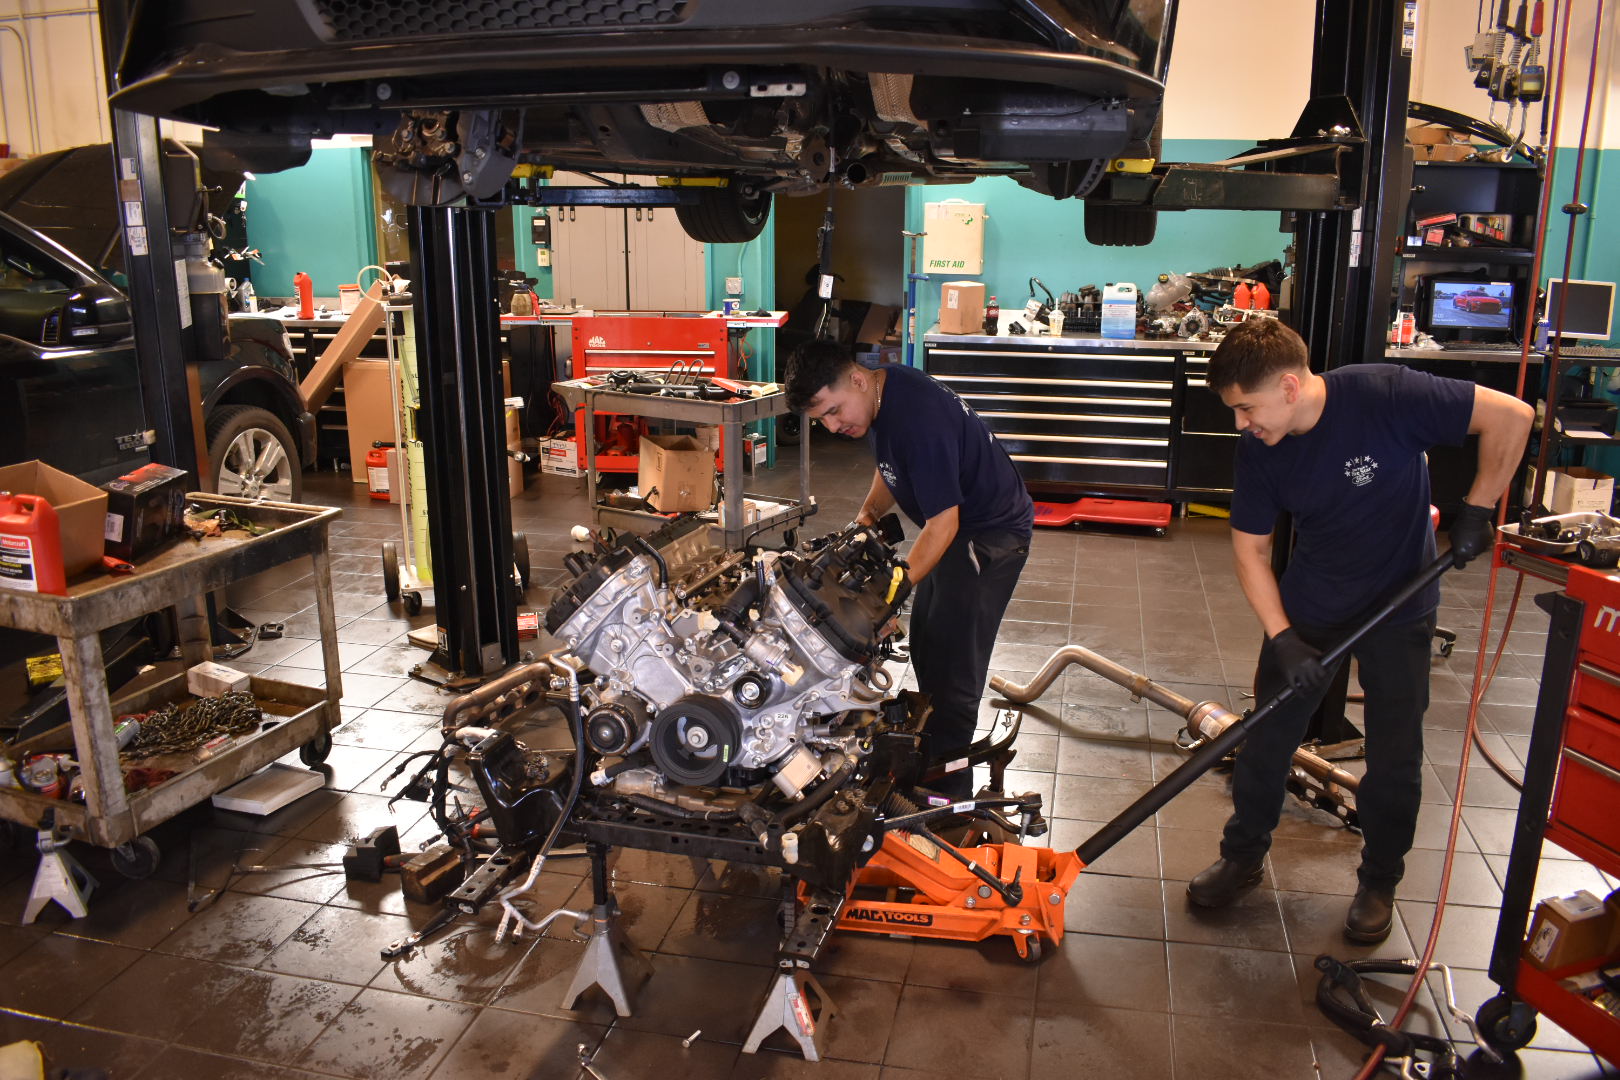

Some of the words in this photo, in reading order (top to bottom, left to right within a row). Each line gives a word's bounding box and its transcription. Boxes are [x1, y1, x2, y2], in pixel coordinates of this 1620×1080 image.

[929, 259, 950, 268] FIRST
[952, 260, 965, 268] AID
[588, 336, 606, 344] MAC
[885, 911, 929, 923] TOOLS
